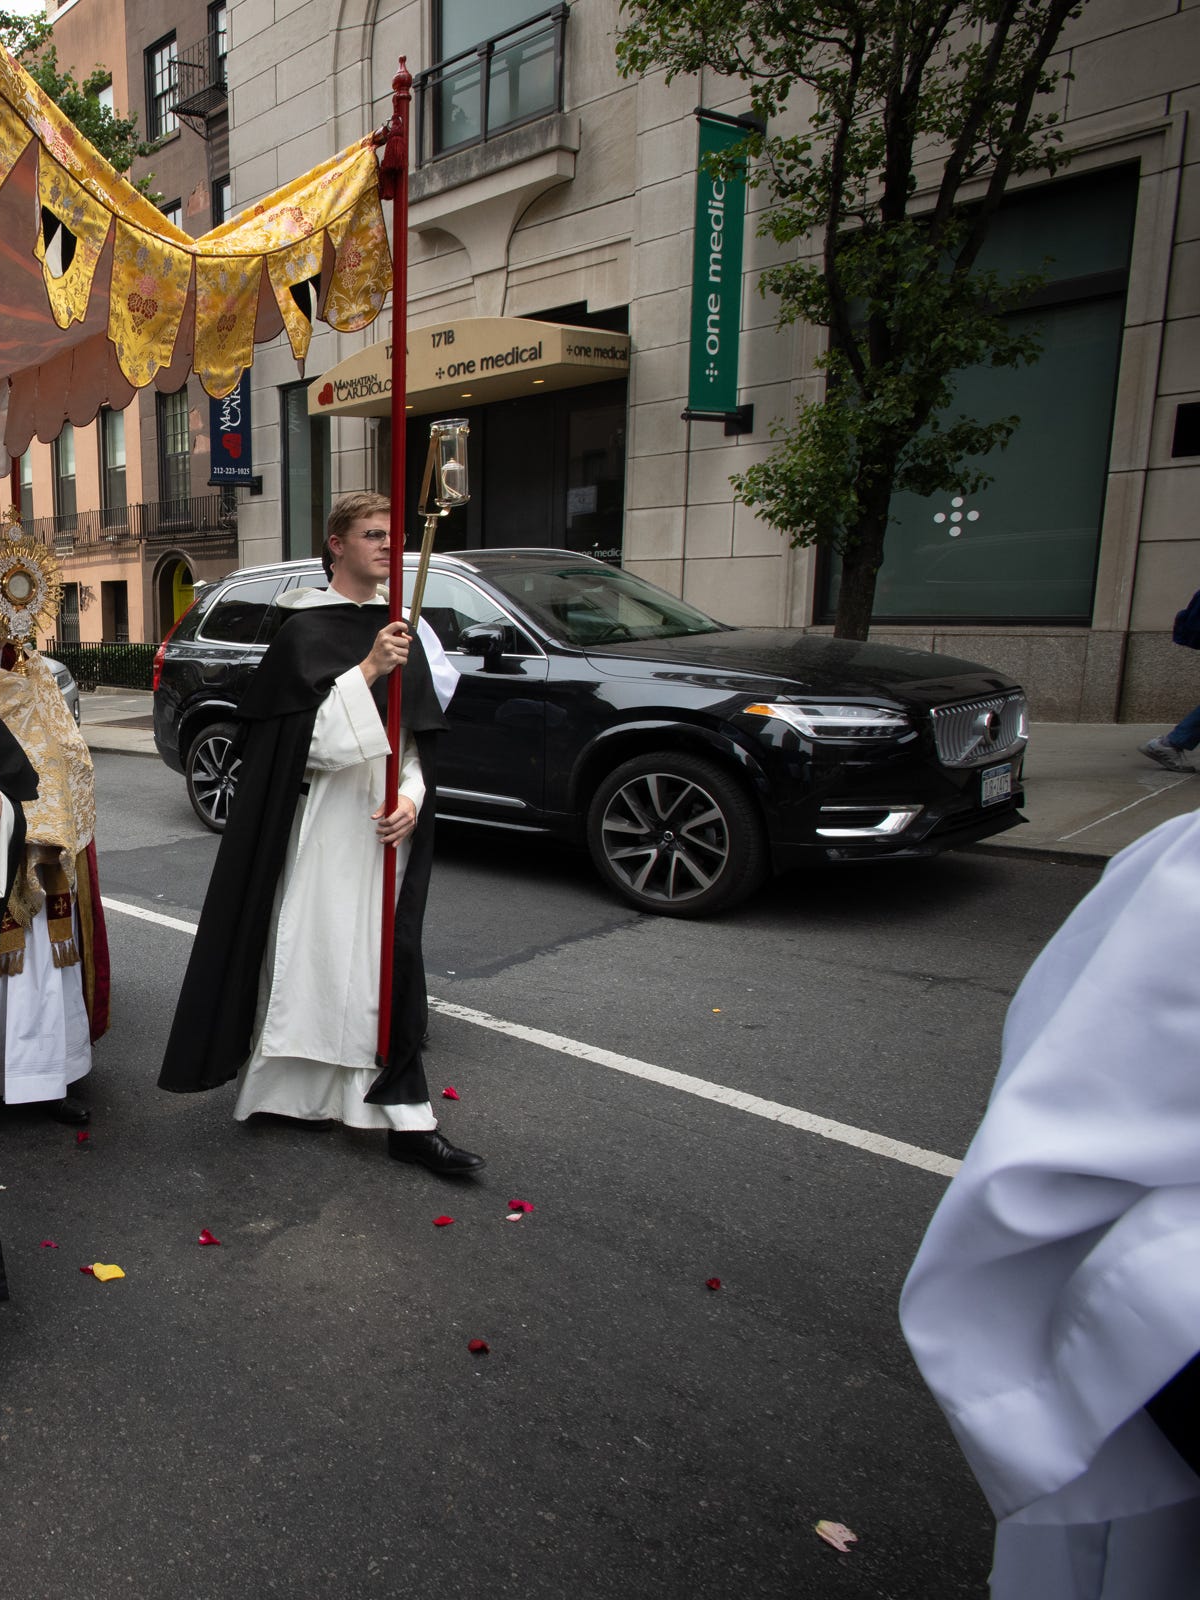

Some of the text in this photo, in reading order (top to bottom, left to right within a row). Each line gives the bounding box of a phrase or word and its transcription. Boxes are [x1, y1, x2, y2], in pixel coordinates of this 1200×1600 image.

[706, 178, 726, 356] one medic
[431, 330, 455, 348] 171B
[447, 341, 542, 378] one medical
[574, 344, 628, 361] one medical
[337, 378, 394, 402] CARDIOLO
[213, 467, 250, 475] 212-223-1025
